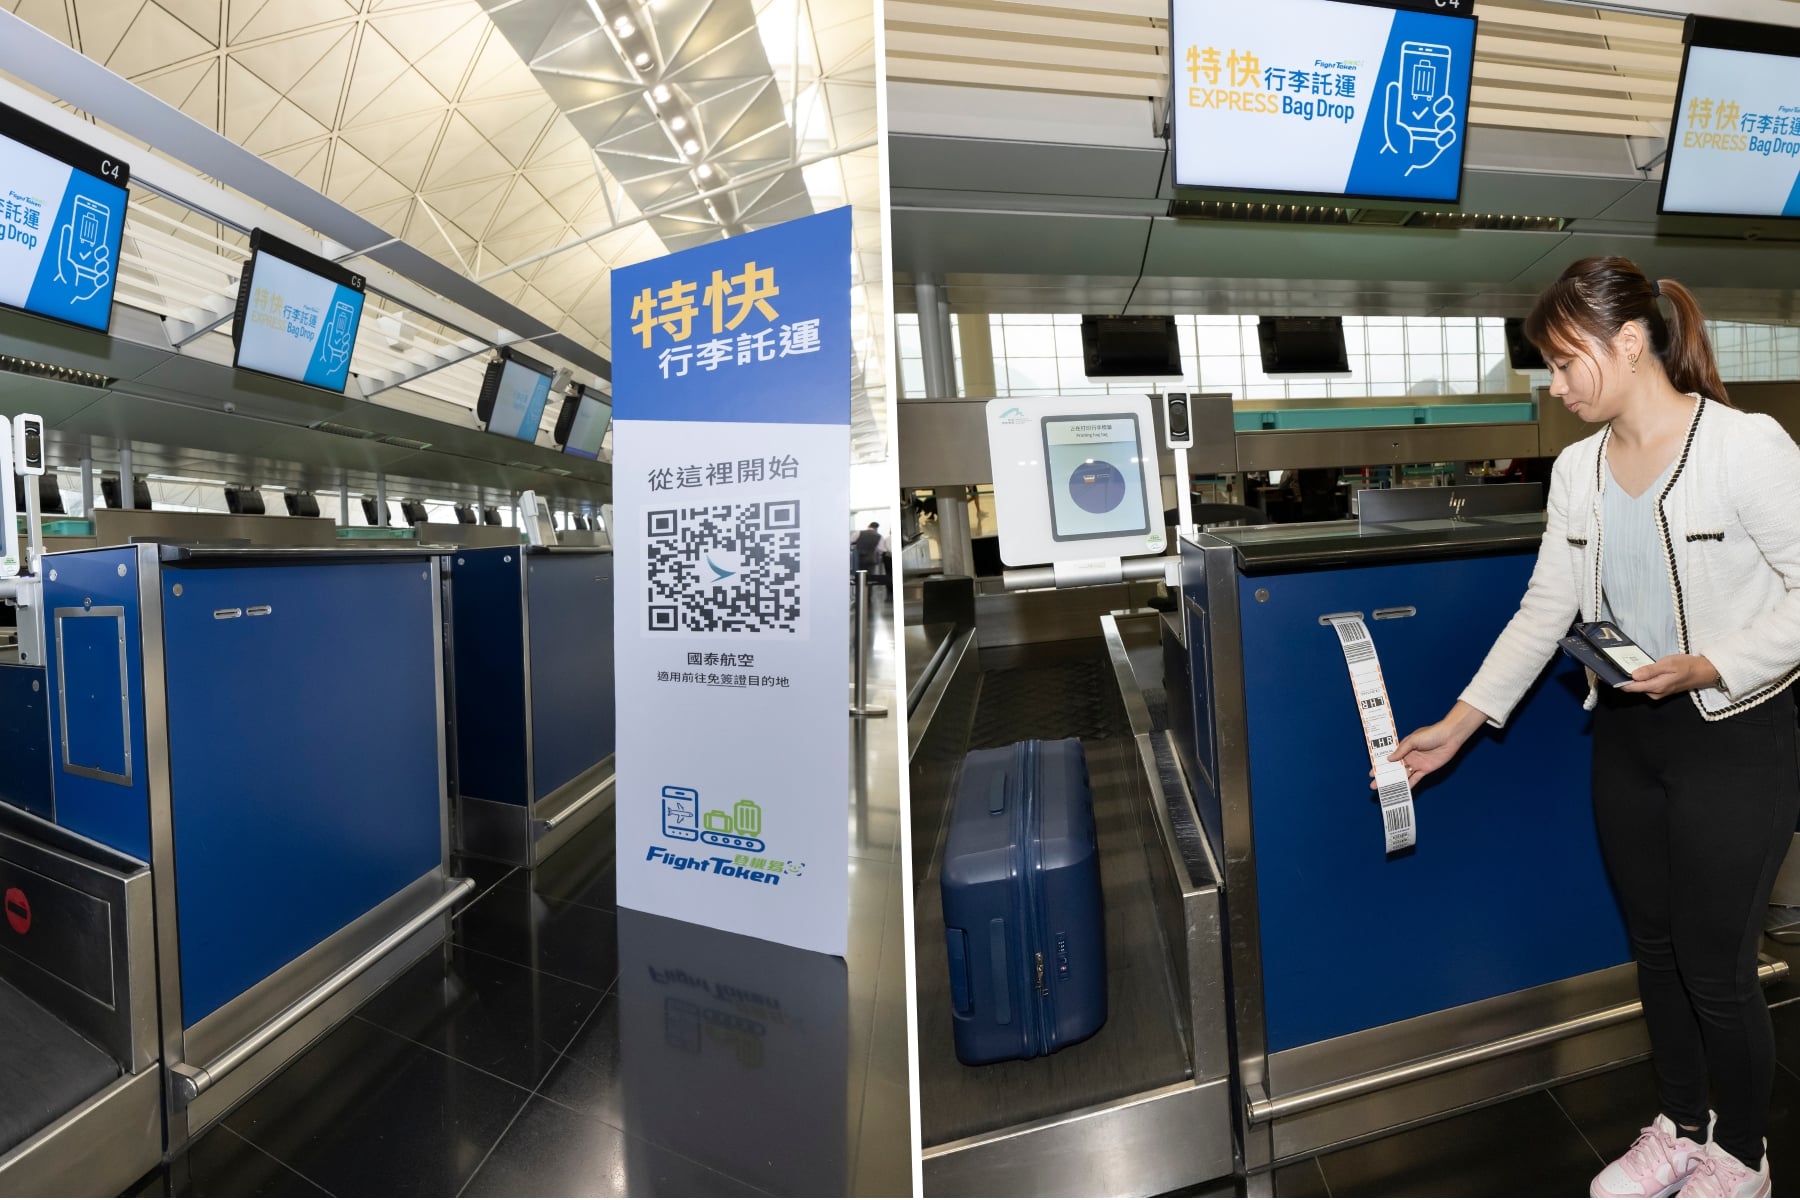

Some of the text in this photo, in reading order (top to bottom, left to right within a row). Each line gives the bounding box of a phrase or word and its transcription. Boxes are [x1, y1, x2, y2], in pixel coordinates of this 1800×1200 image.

[1186, 44, 1356, 98] 特快 行李託運
[1188, 87, 1355, 124] EXPRESS Bag Drop
[1687, 96, 1740, 131] 特快
[1683, 131, 1800, 158] EXPRESS Bag Drop
[101, 160, 120, 180] C4
[7, 224, 37, 250] Drop
[351, 275, 362, 288] C5
[630, 261, 780, 349] 特快
[287, 322, 299, 338] Bag
[300, 326, 315, 342] Drop
[658, 318, 821, 379] 行李託運
[647, 454, 800, 492] 從這裡開始
[687, 652, 754, 668] 國泰航空
[657, 670, 790, 688] 適用前往免簽證目的地
[1361, 696, 1385, 709] LHR
[1371, 736, 1394, 750] LHR
